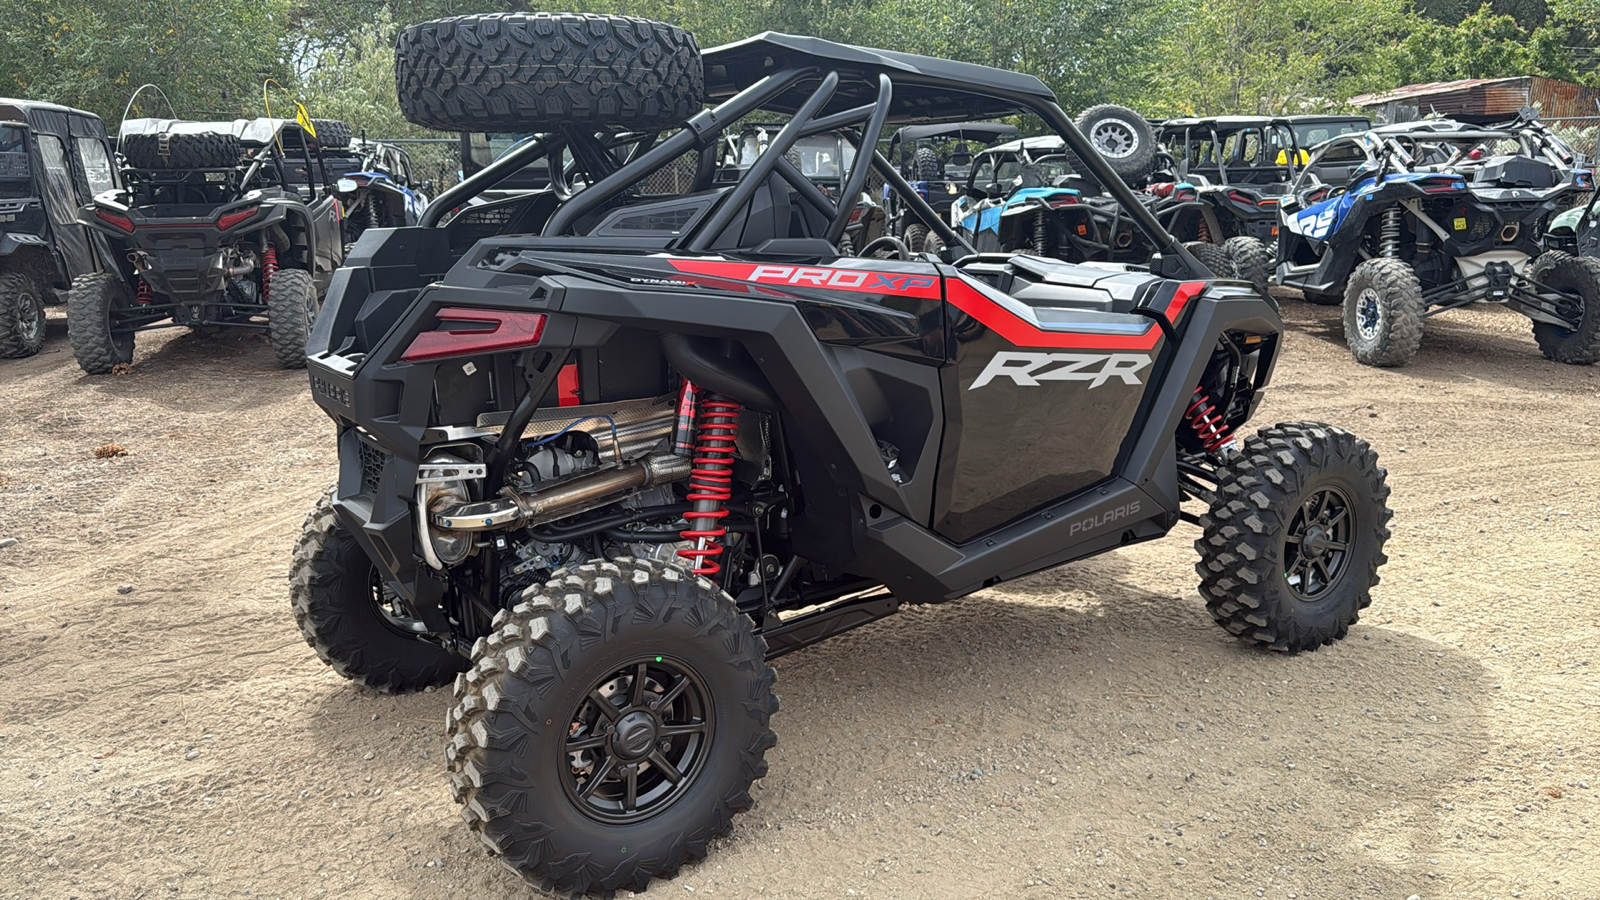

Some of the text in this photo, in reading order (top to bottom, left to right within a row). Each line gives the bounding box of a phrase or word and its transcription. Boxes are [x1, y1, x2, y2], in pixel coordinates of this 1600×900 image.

[747, 265, 935, 290] PRO XP
[968, 351, 1153, 391] RZR
[1069, 500, 1141, 536] POLARIS
